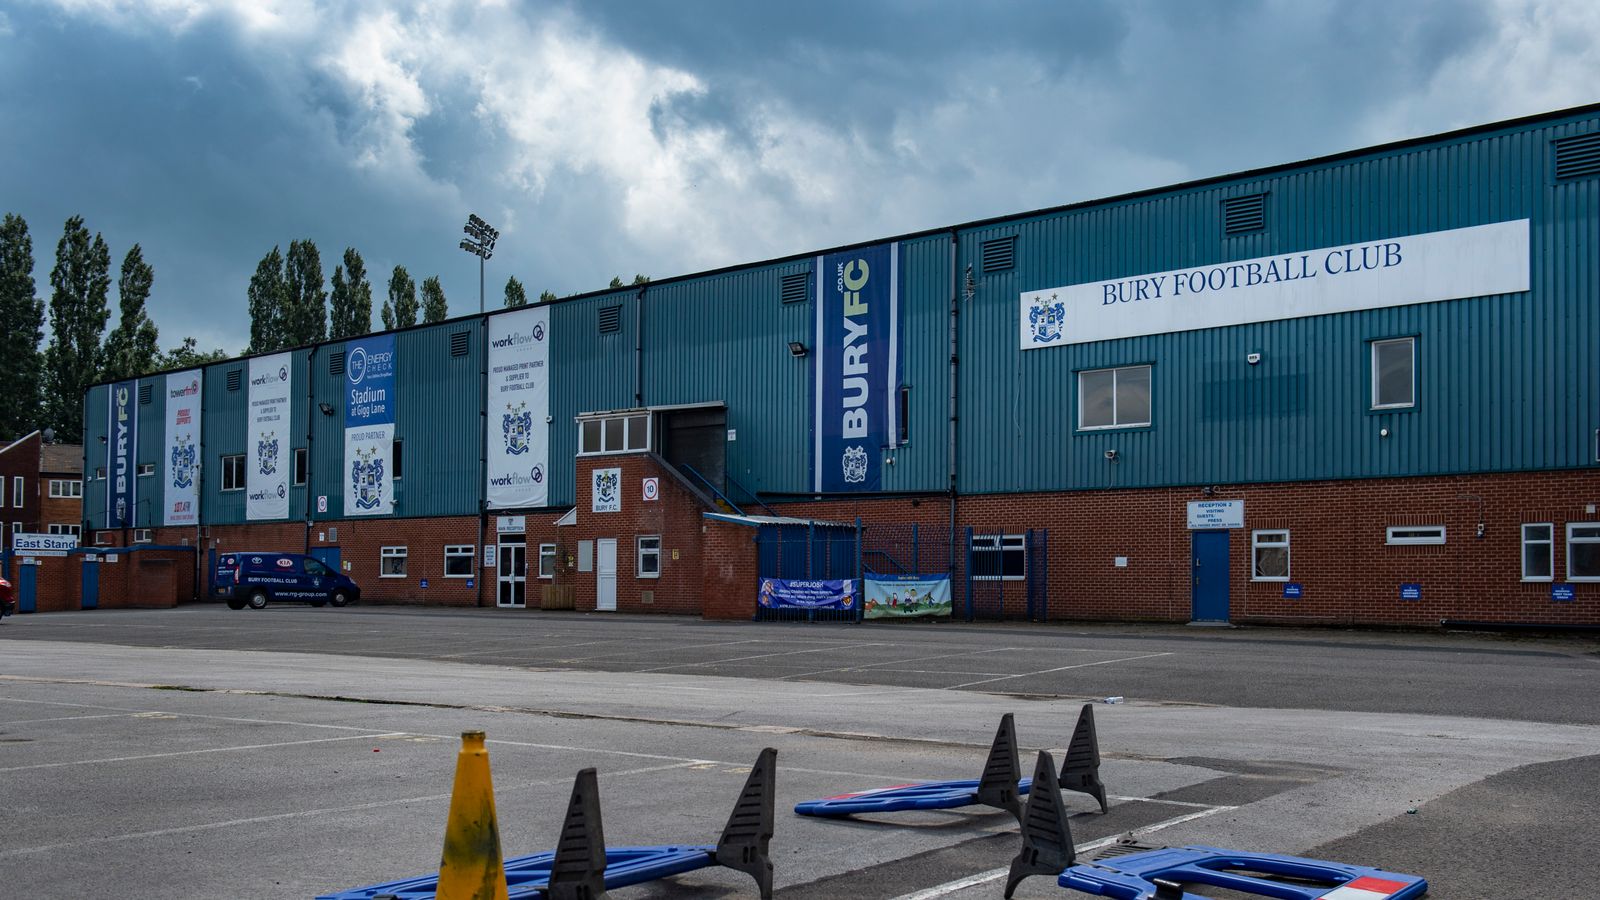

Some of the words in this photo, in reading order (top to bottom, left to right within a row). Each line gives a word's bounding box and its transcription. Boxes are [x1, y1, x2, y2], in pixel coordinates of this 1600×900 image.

[1102, 276, 1167, 306] BURY
[1173, 255, 1317, 296] FOOTBALL
[1325, 242, 1403, 275] CLUB
[492, 332, 533, 348] workflow
[367, 352, 393, 365] ENERGY
[352, 360, 363, 370] THE
[367, 363, 392, 373] CHECK
[251, 373, 278, 386] workflow
[509, 373, 525, 381] SUPPLIER
[351, 386, 386, 405] Stadium
[351, 407, 357, 416] at
[356, 405, 370, 418] Gigg
[371, 403, 385, 414] Lane
[351, 433, 365, 441] PROUD
[365, 431, 386, 440] PARTNER
[491, 472, 531, 486] workflow
[249, 489, 277, 500] workflow
[647, 485, 654, 493] 10
[15, 538, 41, 549] East
[43, 539, 76, 550] Stand
